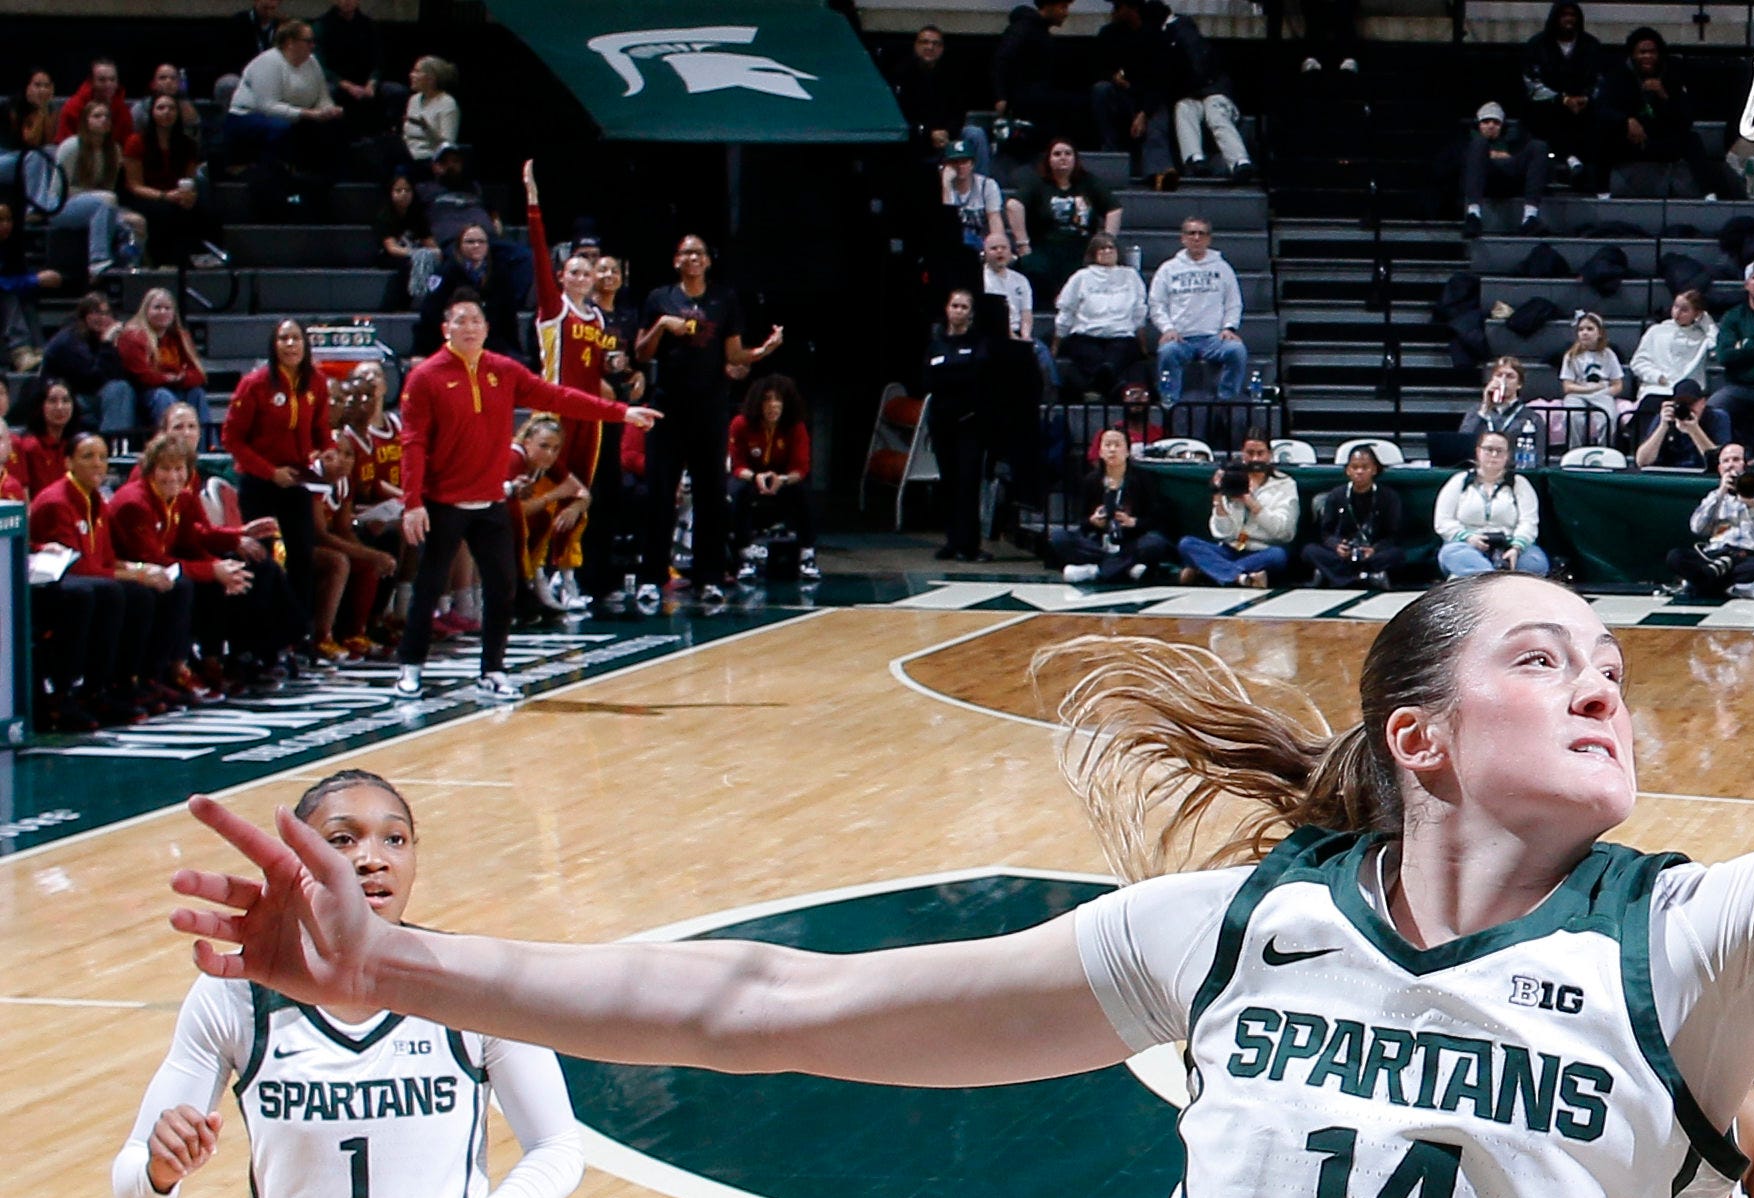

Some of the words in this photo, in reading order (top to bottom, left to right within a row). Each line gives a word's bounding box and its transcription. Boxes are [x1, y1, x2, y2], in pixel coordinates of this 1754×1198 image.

[377, 444, 401, 464] US
[1227, 1006, 1613, 1142] SPARTANS
[258, 1075, 458, 1121] SPARTANS
